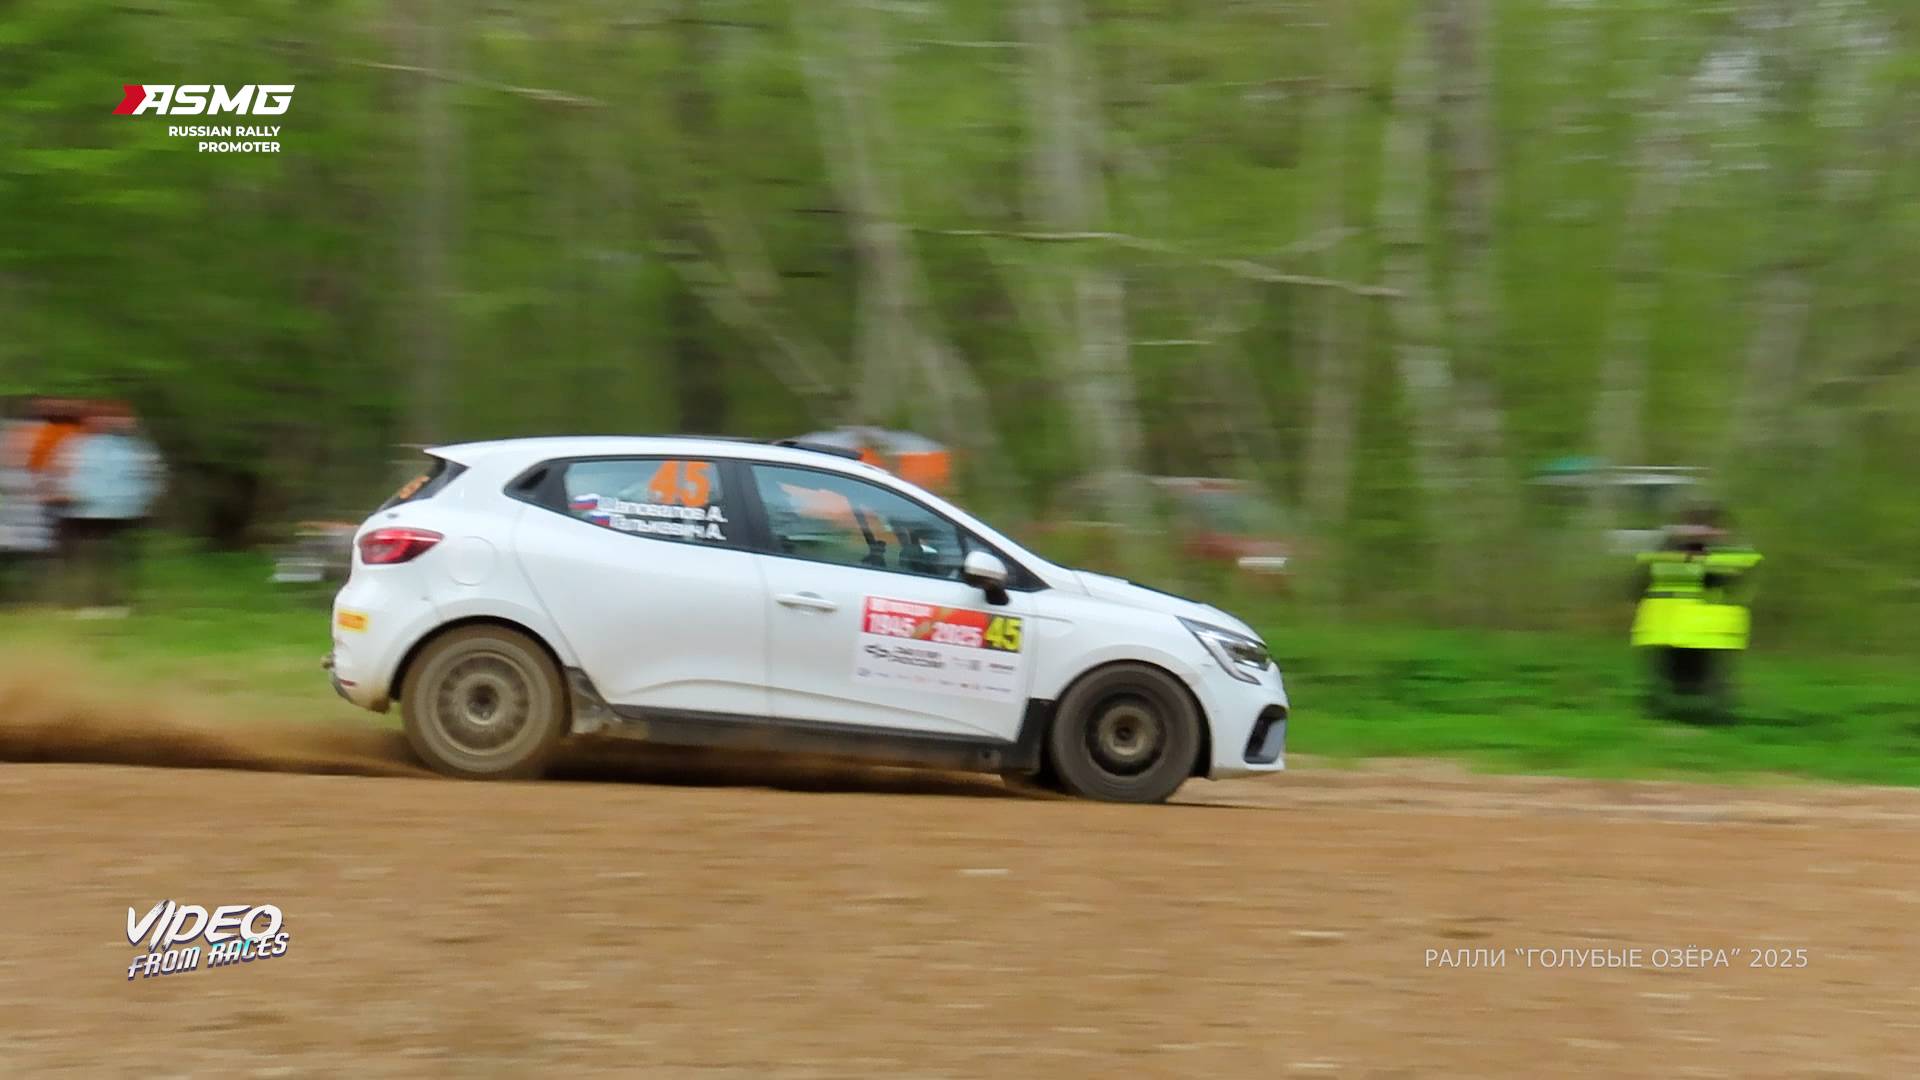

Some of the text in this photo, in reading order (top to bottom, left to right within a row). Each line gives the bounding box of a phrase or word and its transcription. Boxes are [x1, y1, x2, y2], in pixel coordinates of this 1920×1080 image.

[648, 458, 711, 507] 45
[869, 613, 984, 648] 1945 2025
[985, 616, 1022, 651] 45
